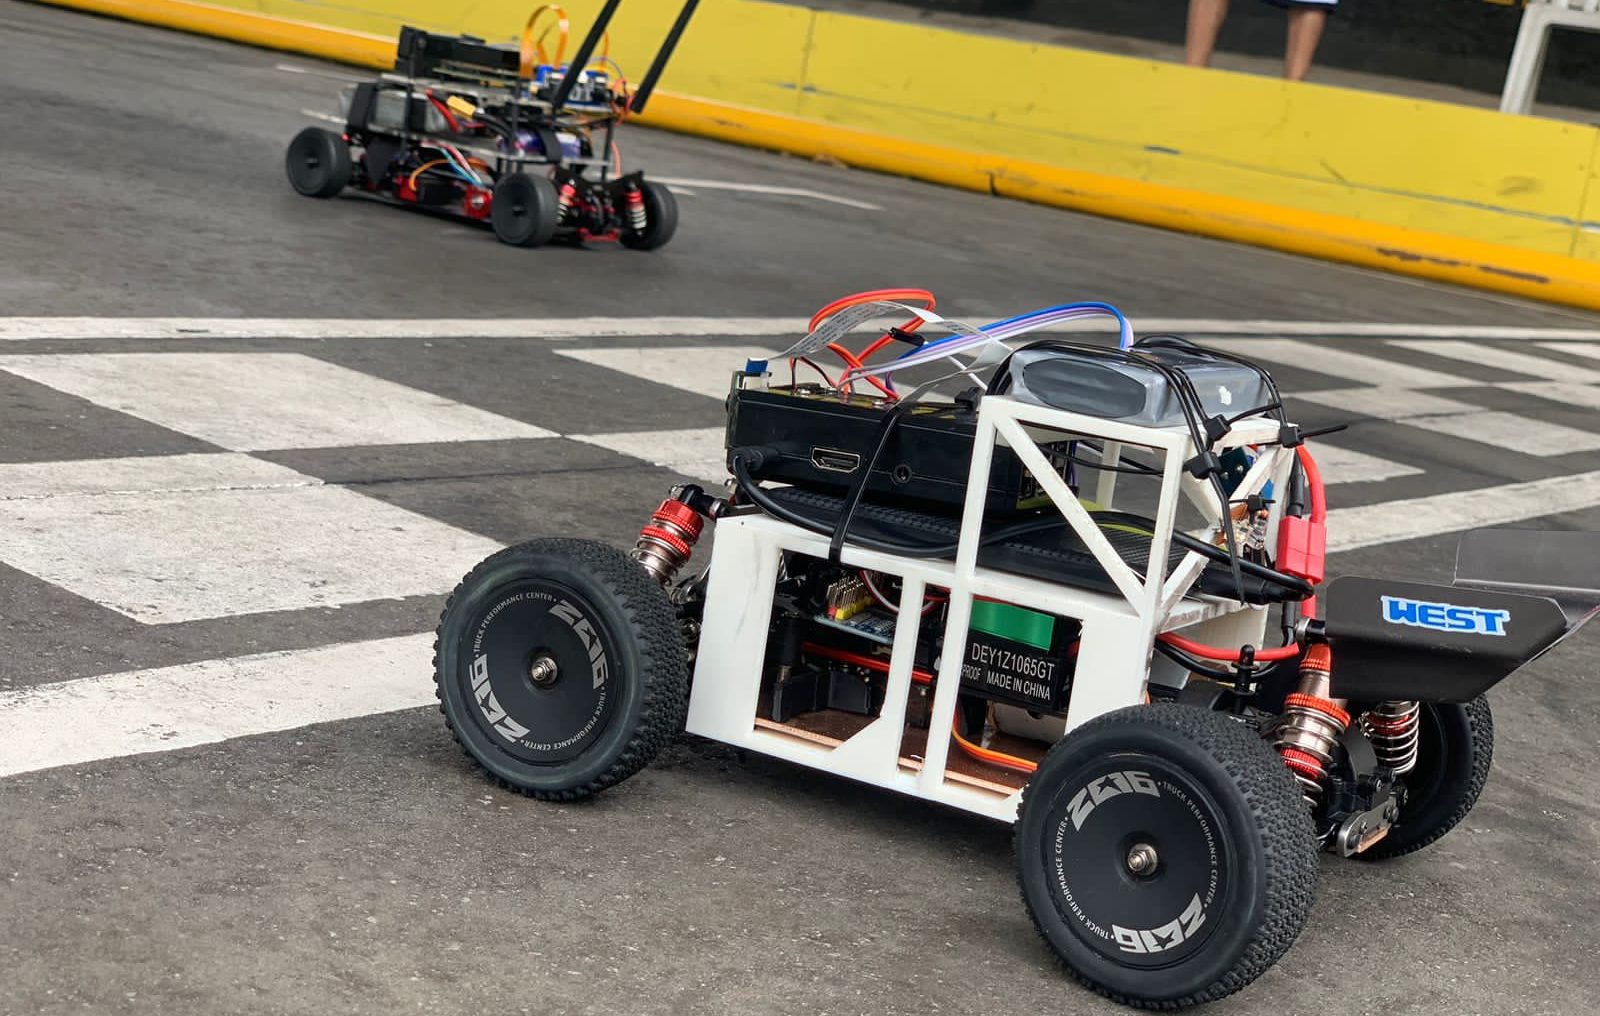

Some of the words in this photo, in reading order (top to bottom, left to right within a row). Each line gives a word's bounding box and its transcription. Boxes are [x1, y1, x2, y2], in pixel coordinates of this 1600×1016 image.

[526, 591, 553, 602] CENTER
[1382, 597, 1509, 636] WEST
[971, 642, 1055, 681] DEY1Z1065GT
[986, 670, 1011, 690] MADE
[1013, 677, 1022, 692] IN
[1023, 680, 1051, 700] CHINA
[524, 740, 551, 751] CENTER
[1055, 820, 1068, 854] CENTER
[1162, 781, 1187, 803] TRUCK
[1186, 799, 1217, 866] PERFORMANCE
[1205, 869, 1218, 904] CENTER
[1055, 856, 1087, 921] PERFORMANCE
[1085, 918, 1109, 940] TRUCK
